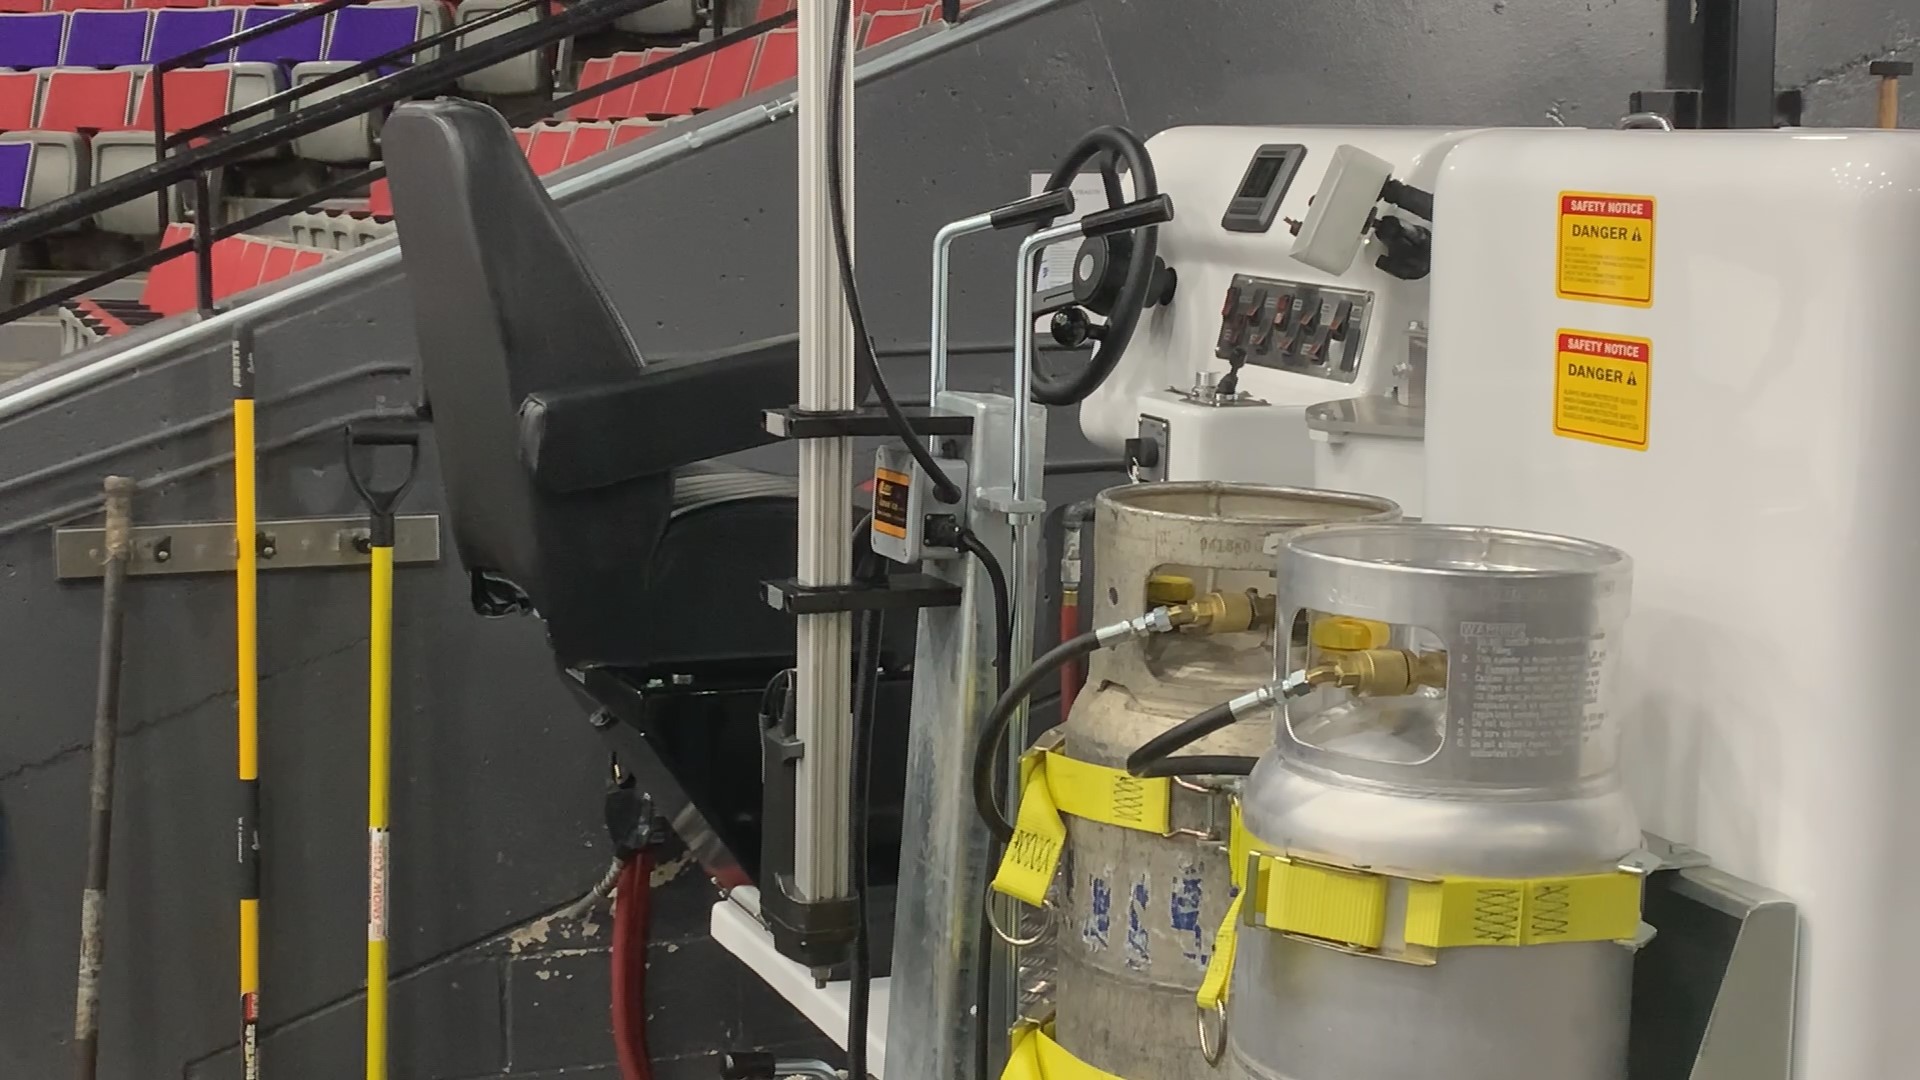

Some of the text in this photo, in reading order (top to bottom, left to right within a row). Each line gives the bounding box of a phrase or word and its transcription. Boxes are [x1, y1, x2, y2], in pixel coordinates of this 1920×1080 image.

[1571, 200, 1643, 215] SAFETY NOTICE
[1572, 224, 1627, 240] DANGER
[1567, 338, 1639, 358] SAFETY NOTICE
[1568, 363, 1623, 383] DANGER
